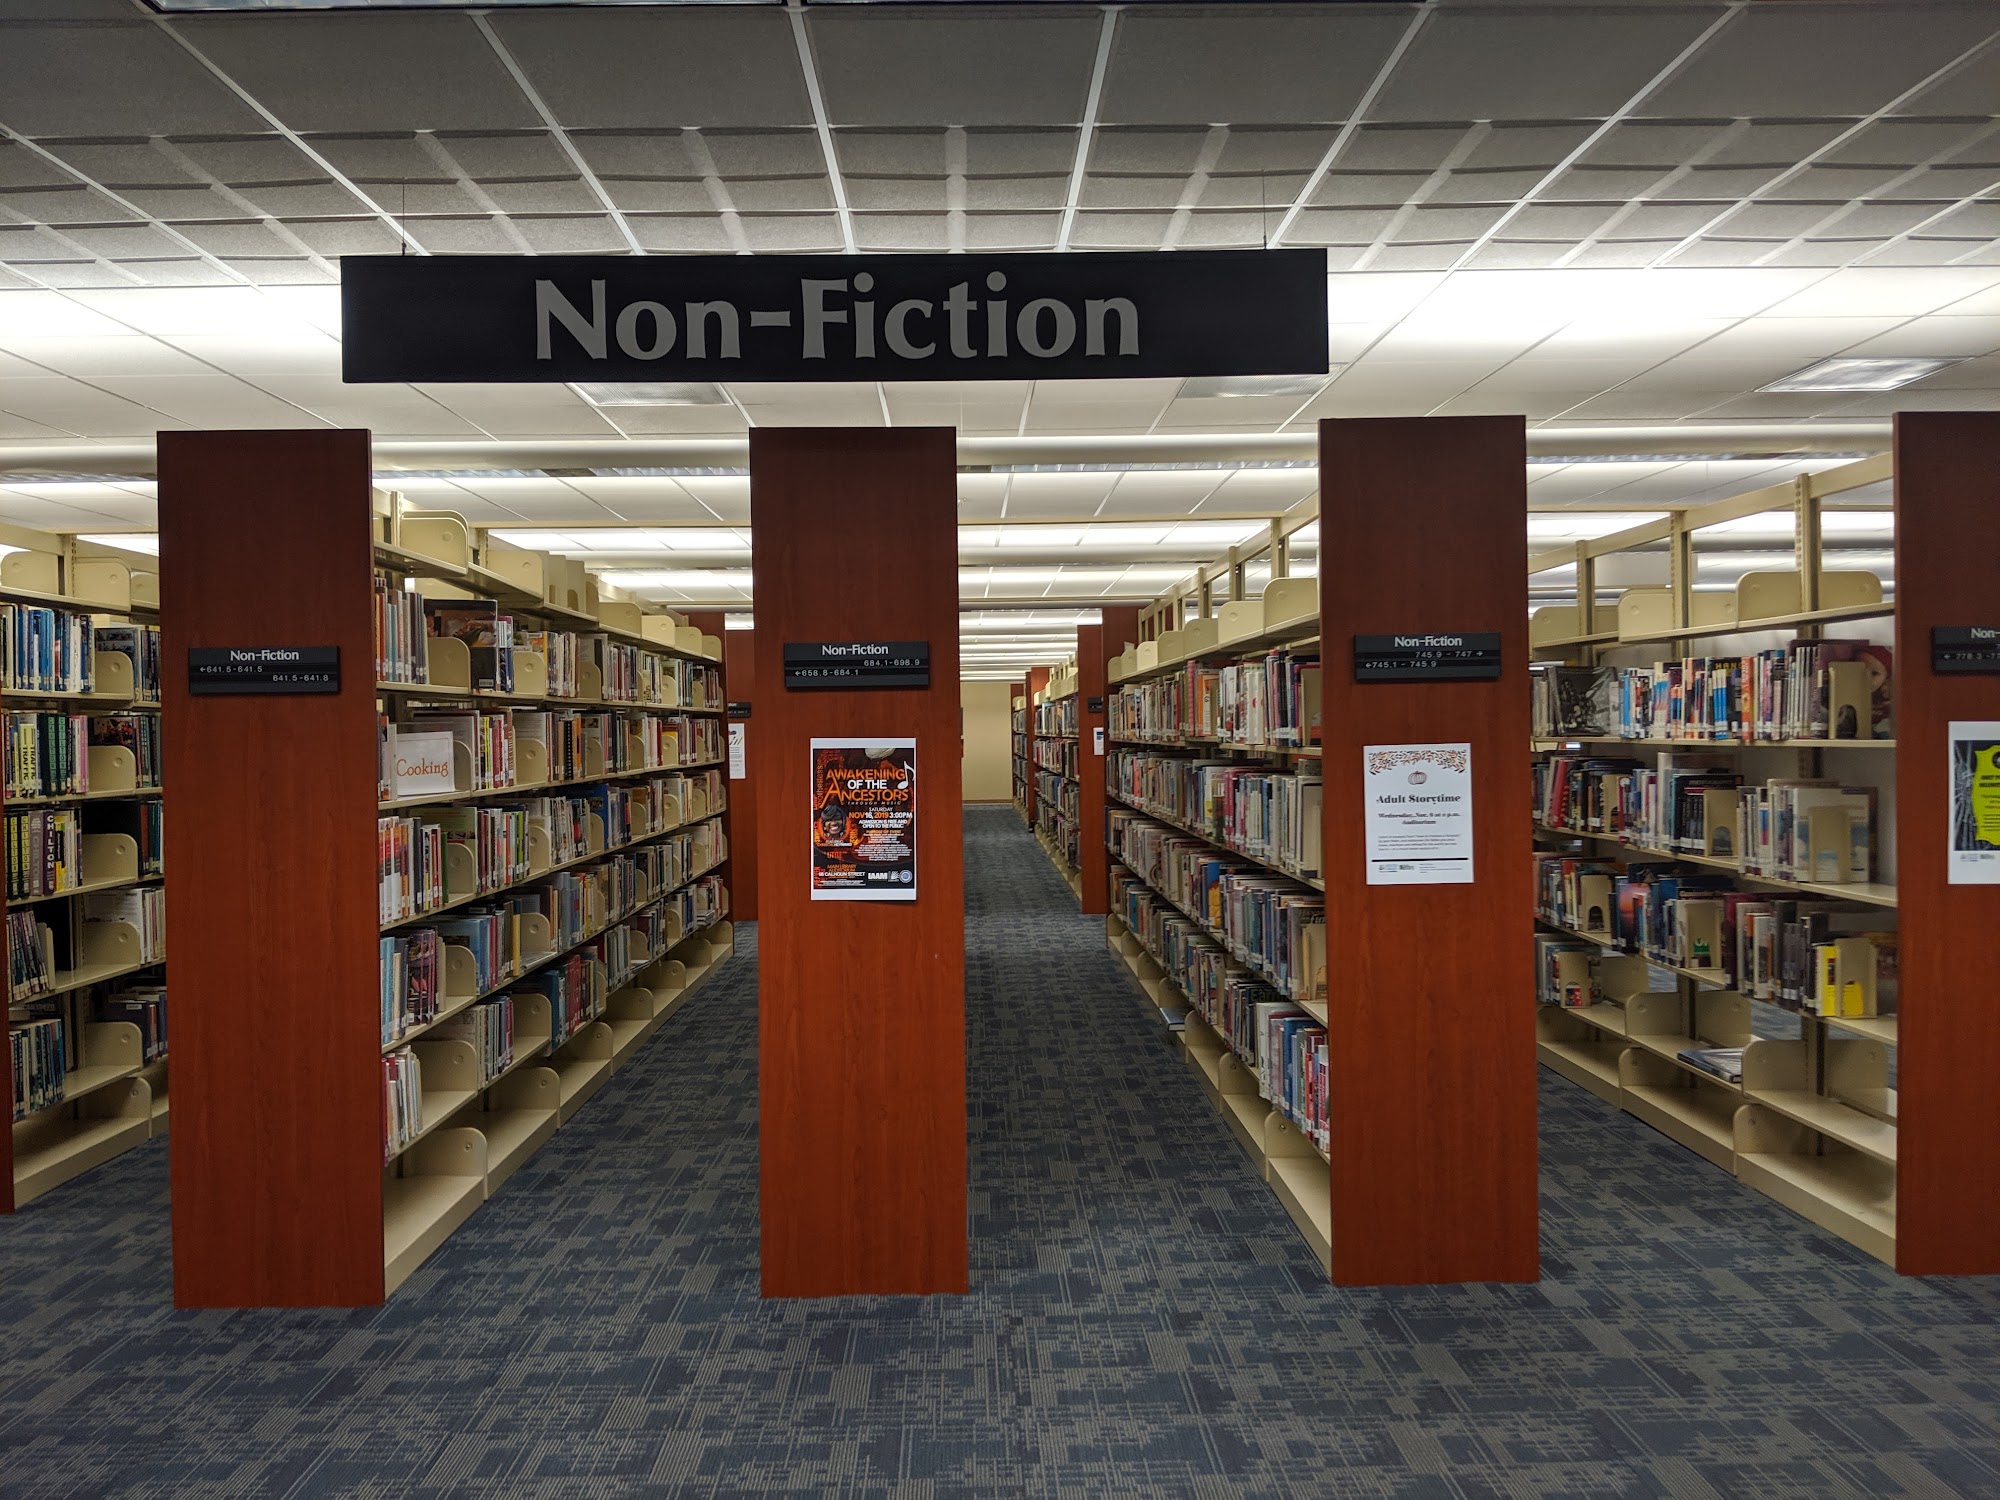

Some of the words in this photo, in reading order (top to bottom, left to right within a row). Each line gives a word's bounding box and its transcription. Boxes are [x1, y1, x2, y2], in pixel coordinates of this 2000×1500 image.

[534, 271, 1140, 361] Non-Fiction
[1394, 635, 1463, 647] Non-Fiction
[230, 649, 300, 661] Non-Fiction
[822, 644, 889, 655] Non-Fiction
[863, 659, 920, 667] 684.1-698.9
[1410, 660, 1437, 668] 745.9
[206, 665, 263, 673] 641.5-641.5
[801, 669, 859, 677] 658.8-684.1
[396, 758, 449, 777] Cooking
[826, 769, 906, 780] AWAKENING
[847, 780, 863, 790] OF
[864, 780, 887, 790] THE
[820, 776, 909, 808] ANCESTORS
[1377, 794, 1406, 804] Adult
[1408, 793, 1462, 805] Storytime
[47, 815, 55, 869] CHILTON
